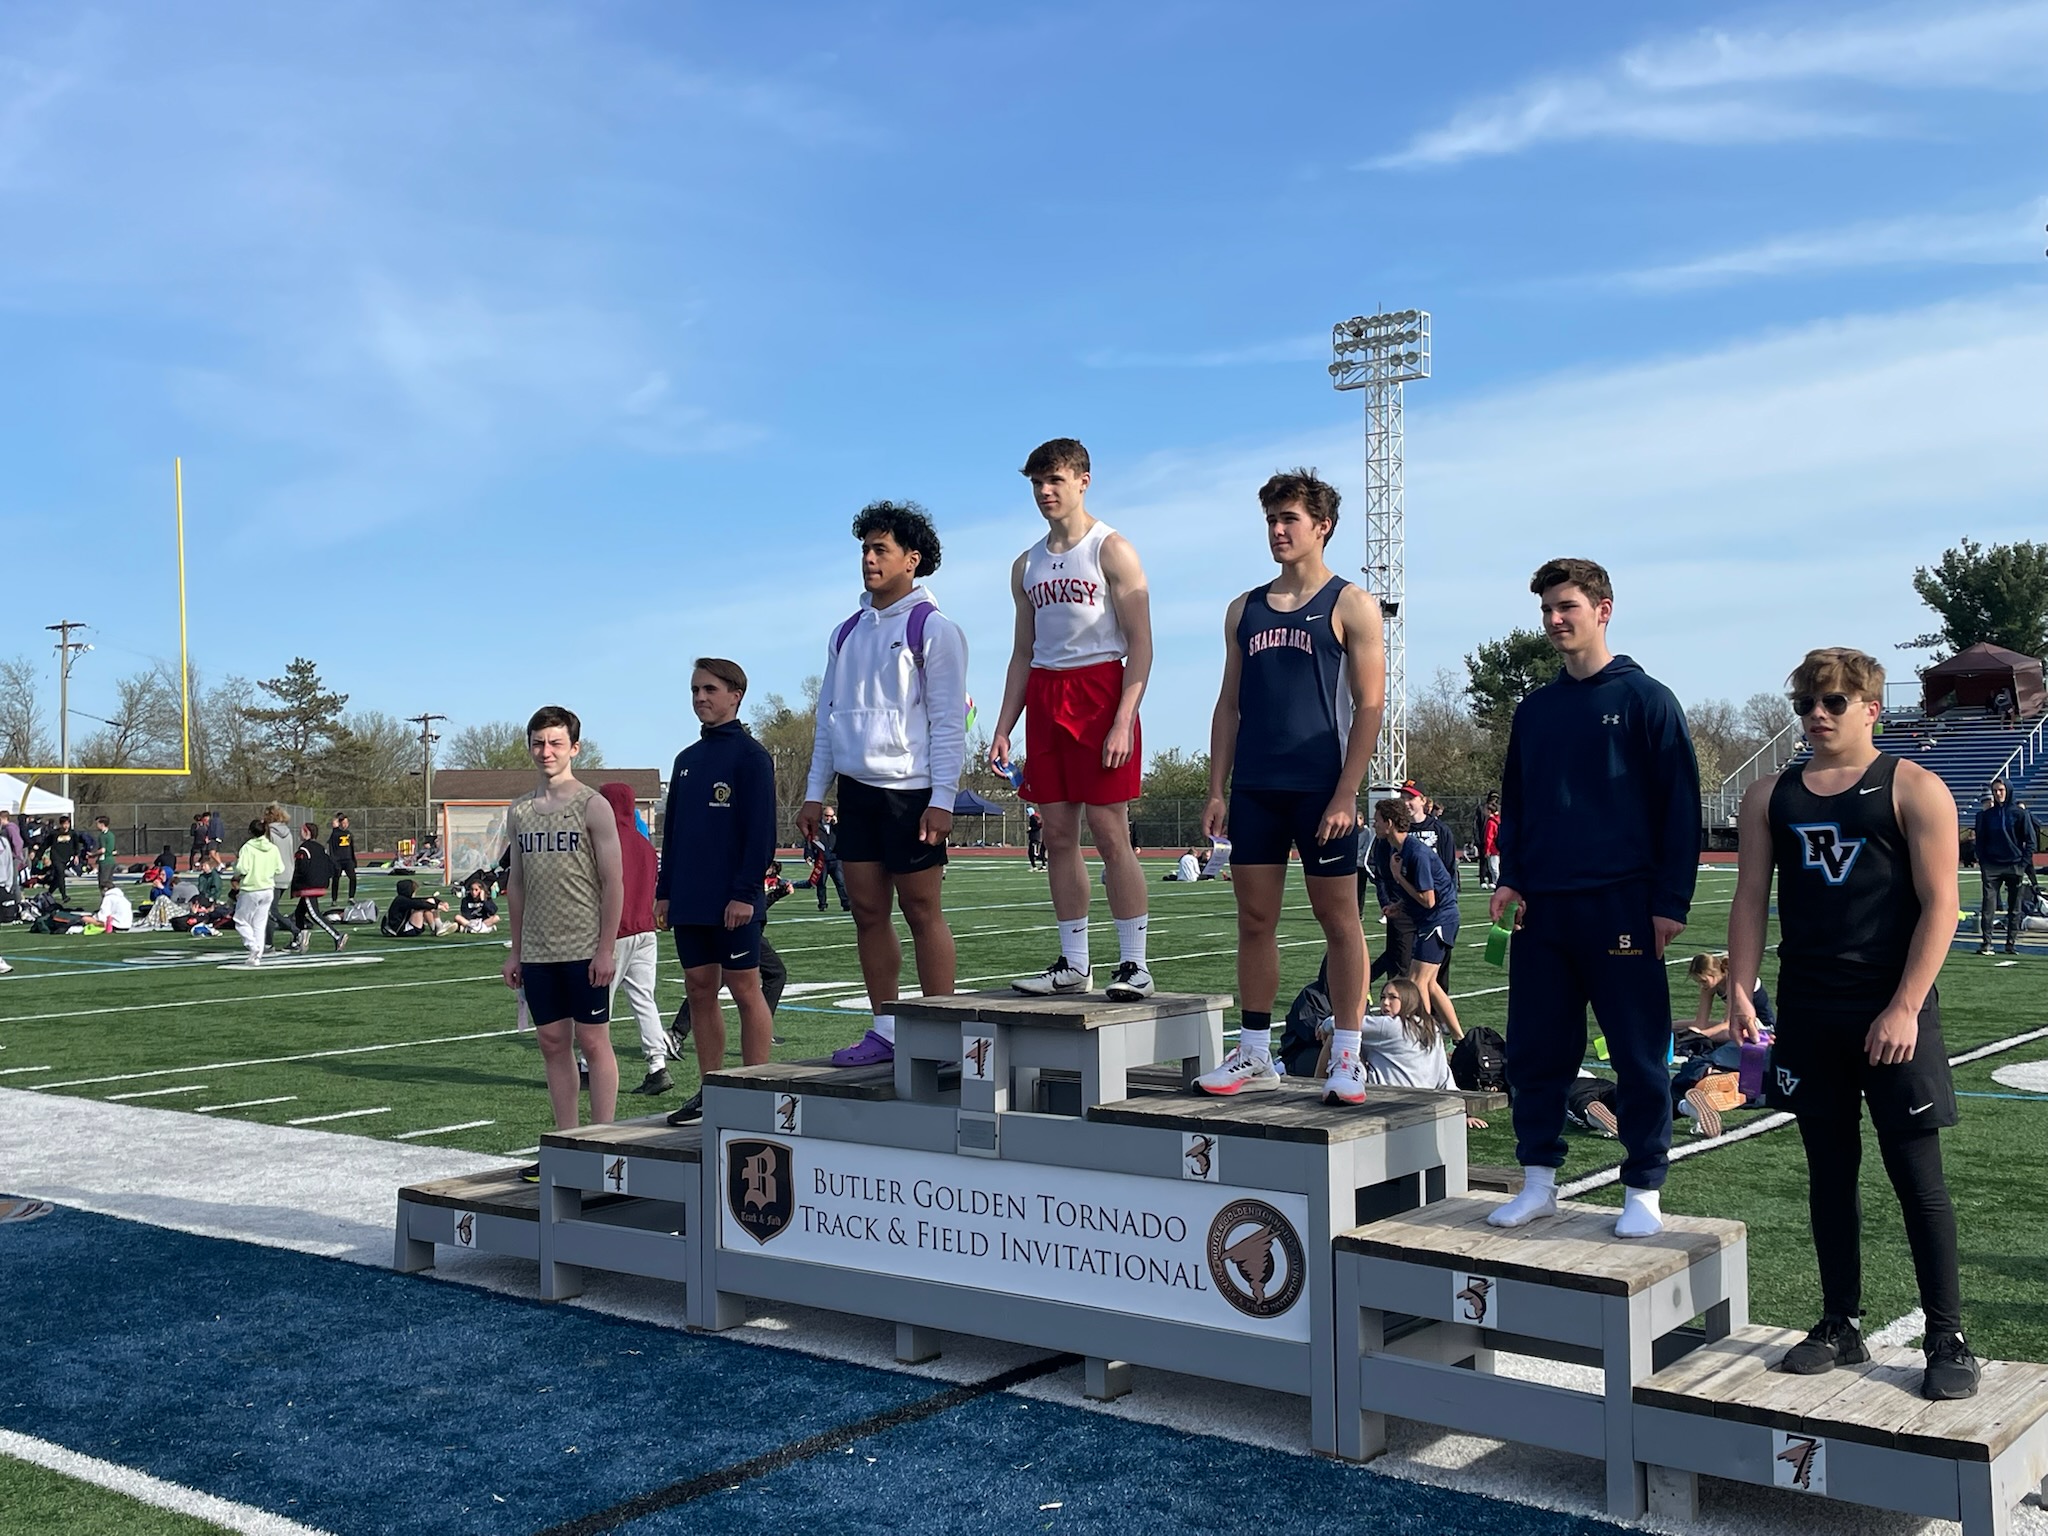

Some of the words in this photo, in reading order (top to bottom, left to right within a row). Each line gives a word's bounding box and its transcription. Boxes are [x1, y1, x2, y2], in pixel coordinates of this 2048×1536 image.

[1248, 627, 1288, 656] SHALER
[1288, 628, 1313, 655] AREA
[1787, 821, 1867, 886] RV
[1619, 934, 1631, 949] S
[780, 1094, 797, 1131] 2
[608, 1157, 624, 1191] 4
[1191, 1134, 1211, 1177] 3
[741, 1146, 777, 1211] B
[814, 1168, 905, 1205] BUTLER
[914, 1180, 1025, 1220] GOLDEN
[1036, 1194, 1186, 1242] TORNADO
[459, 1212, 472, 1245] 6
[799, 1205, 880, 1242] TRACK
[888, 1217, 909, 1246] &
[917, 1220, 989, 1257] FIELD
[1001, 1232, 1207, 1292] INVITATIONAL
[1212, 1223, 1225, 1260] BUTLER
[1224, 1206, 1255, 1224] GOLDEN
[1464, 1276, 1487, 1320] 5
[1786, 1433, 1817, 1484] 7
